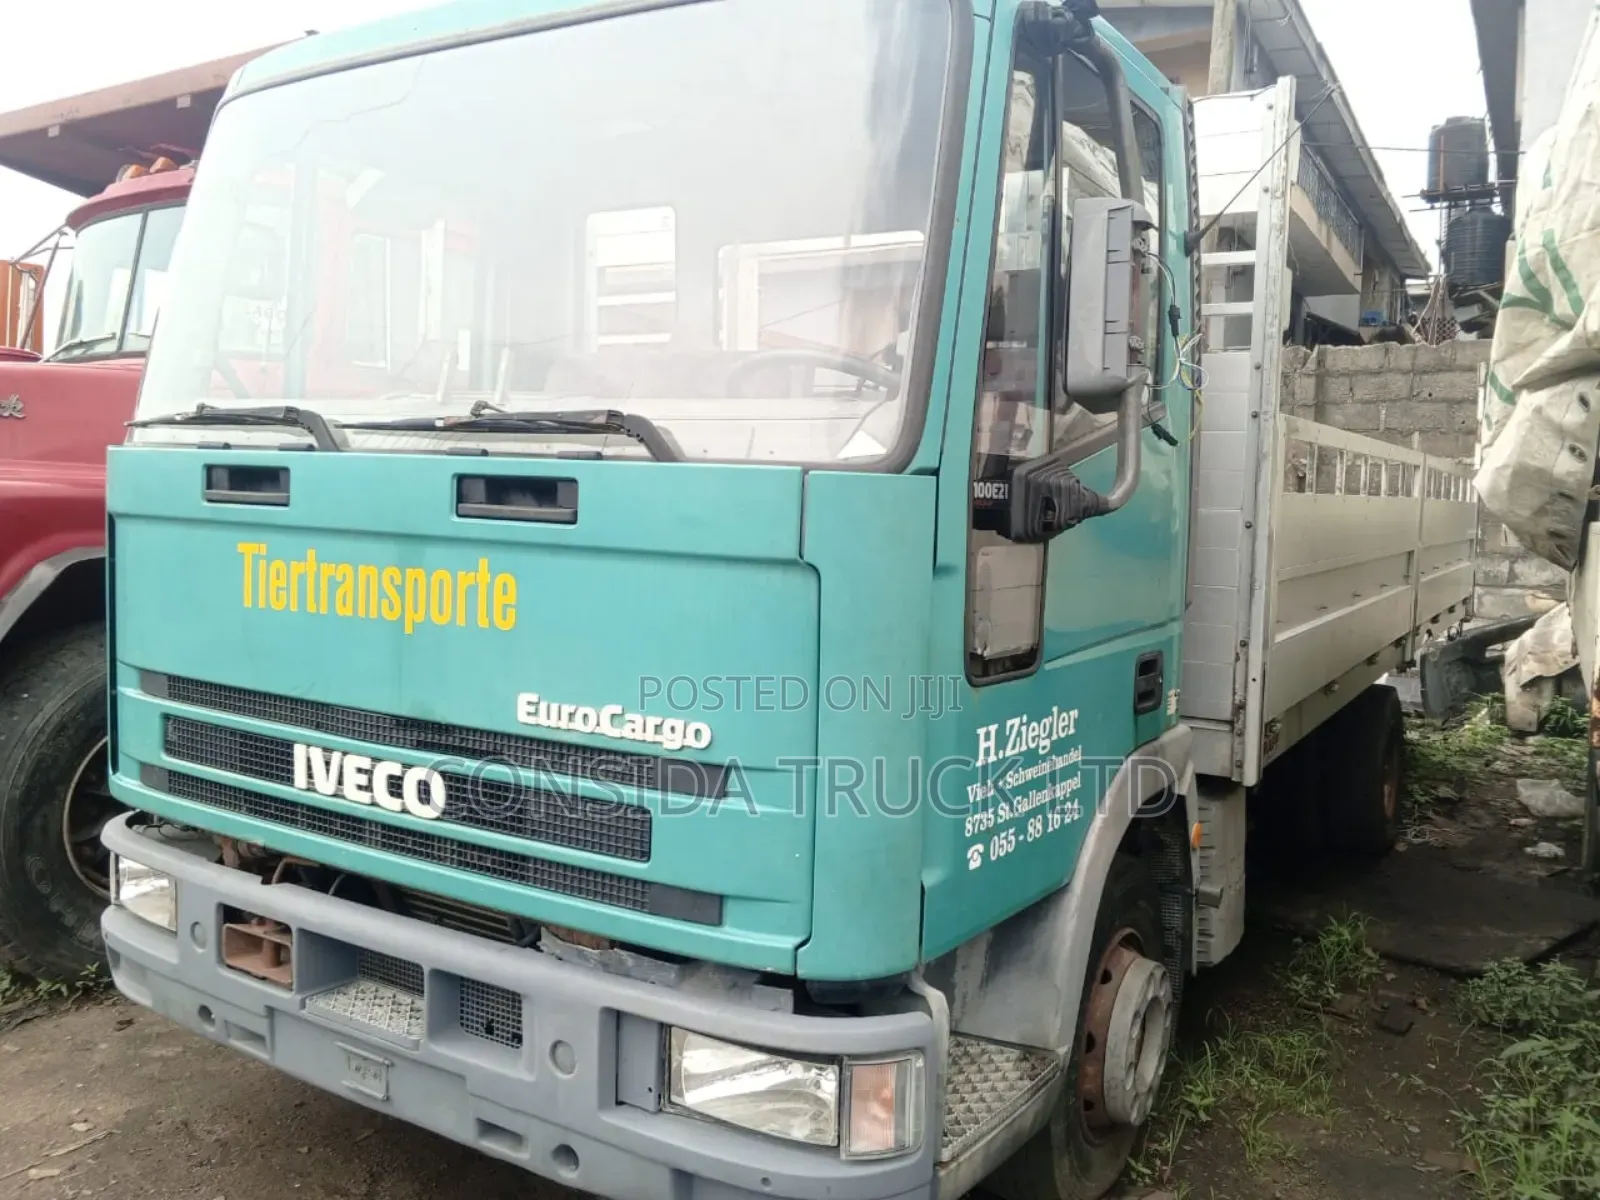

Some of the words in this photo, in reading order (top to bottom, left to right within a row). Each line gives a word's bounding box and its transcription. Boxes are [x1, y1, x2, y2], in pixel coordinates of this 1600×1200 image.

[237, 542, 518, 635] Tiertransporte
[516, 692, 712, 750] EuroCargo
[293, 743, 447, 820] IVECO
[964, 807, 995, 838] 8735
[989, 828, 1016, 861] 055
[1026, 814, 1043, 843] 88
[1047, 806, 1061, 832] 16
[1064, 798, 1080, 824] 24
